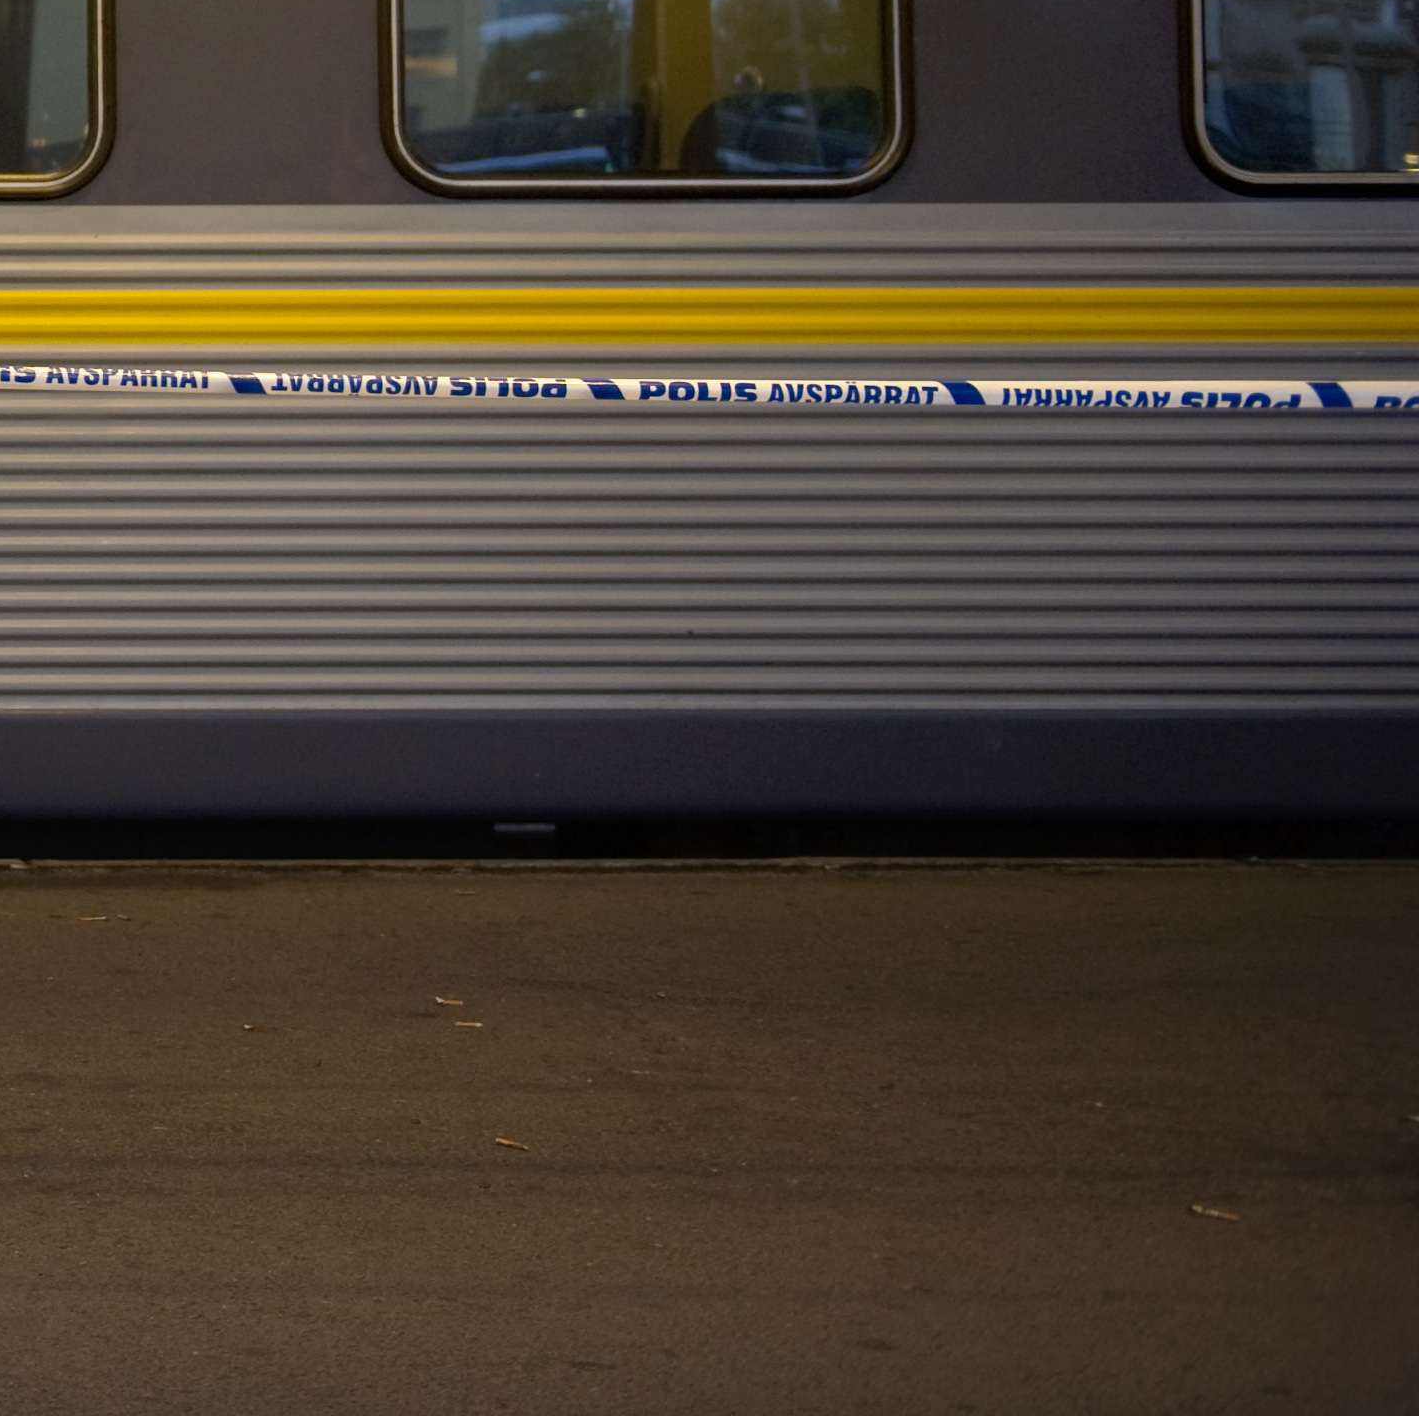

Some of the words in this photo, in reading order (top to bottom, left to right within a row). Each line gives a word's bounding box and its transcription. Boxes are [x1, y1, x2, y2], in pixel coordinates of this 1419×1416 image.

[270, 373, 439, 396] AVSPÄRRAT
[449, 377, 568, 398] POLIS
[638, 380, 758, 402] POLIS
[766, 381, 940, 404] AVSPÄRRAT
